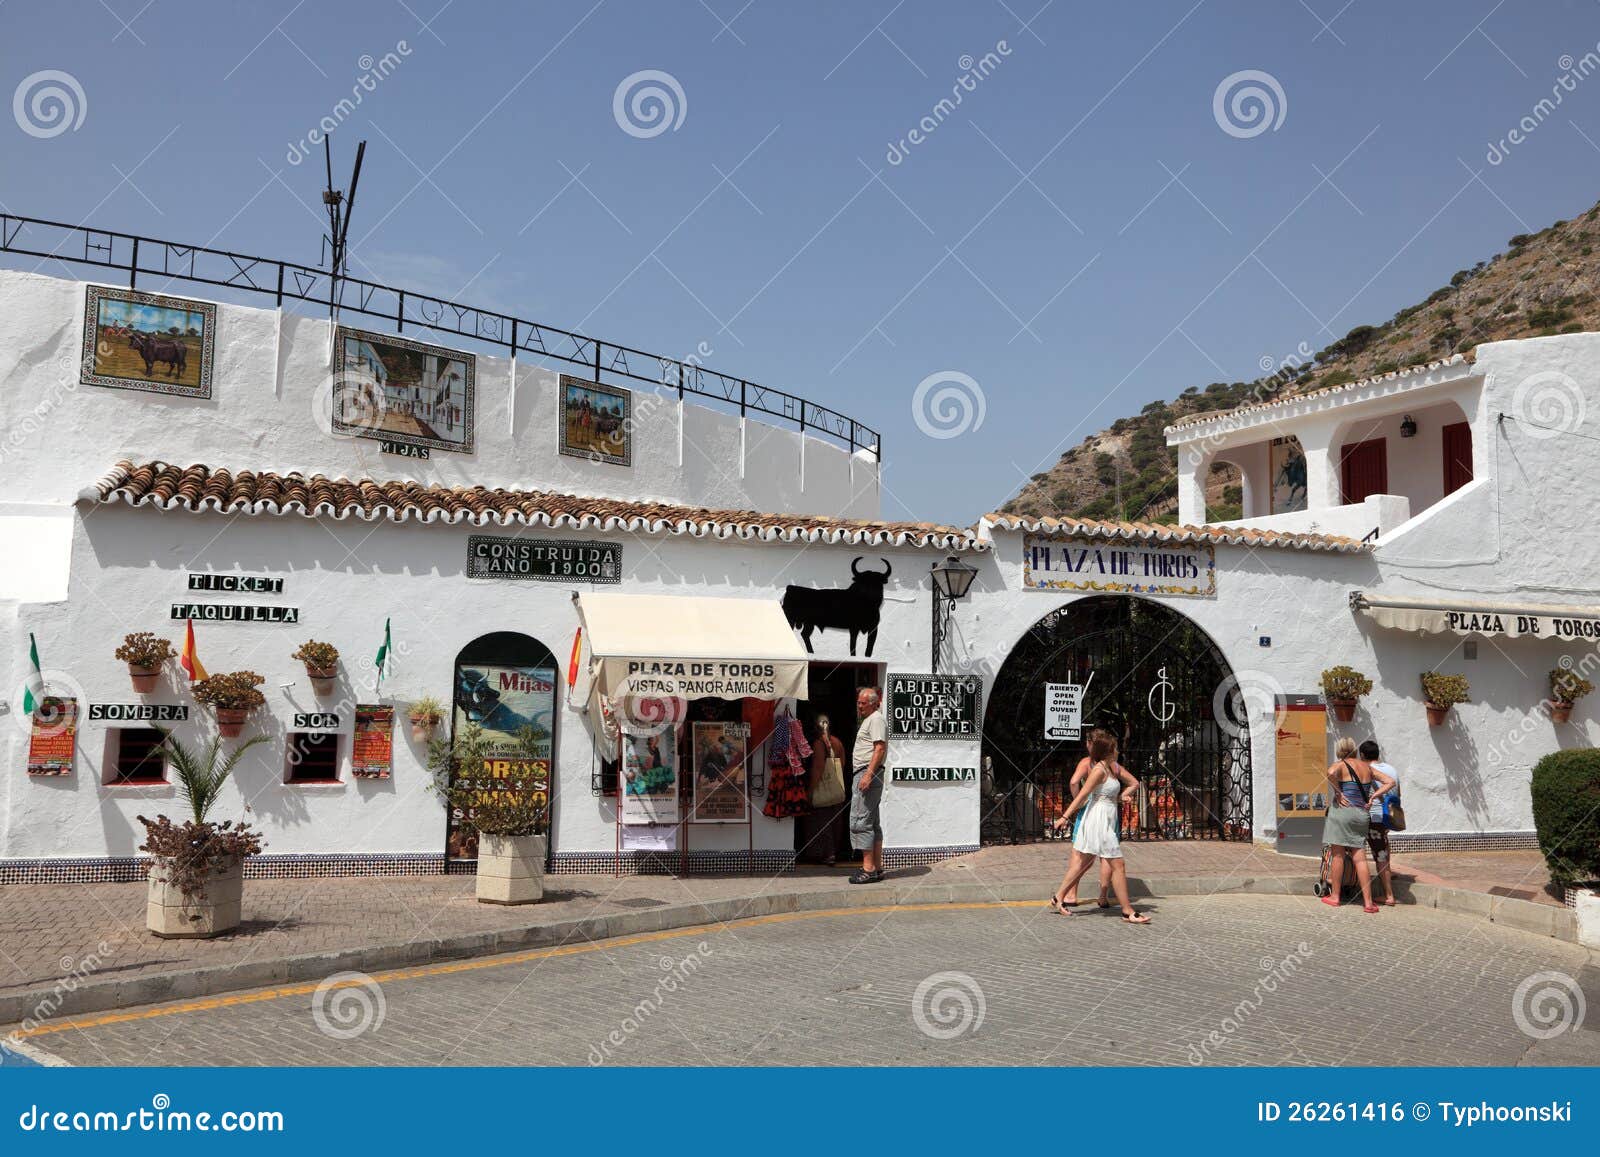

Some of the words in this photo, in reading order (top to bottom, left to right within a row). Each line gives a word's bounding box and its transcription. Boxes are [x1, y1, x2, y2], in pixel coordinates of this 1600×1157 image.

[378, 440, 429, 459] MIJAS
[476, 543, 614, 563] CONSTRUIDA
[550, 561, 601, 576] 1900
[1032, 546, 1106, 575] PLAZA
[1111, 551, 1135, 576] DE
[1139, 552, 1198, 579] TOROS
[190, 575, 281, 592] TICKET
[173, 605, 297, 622] TAQUILLA
[1449, 612, 1505, 632] PLAZA
[1517, 616, 1540, 633] DE
[1553, 619, 1600, 637] TOROS
[629, 662, 686, 676] PLAZA
[691, 663, 714, 676] DE
[719, 664, 774, 677] TOROS
[500, 672, 552, 694] Mijas
[628, 679, 674, 693] VISTAS
[678, 678, 775, 694] PANORÁMICAS
[894, 680, 976, 694] ABIERTO
[912, 694, 959, 707] OPEN
[91, 704, 186, 720] SOMBRA
[894, 707, 963, 720] OUVERT
[295, 714, 338, 728] SOL
[901, 720, 970, 733] VISITE
[894, 768, 976, 780] TAURINA
